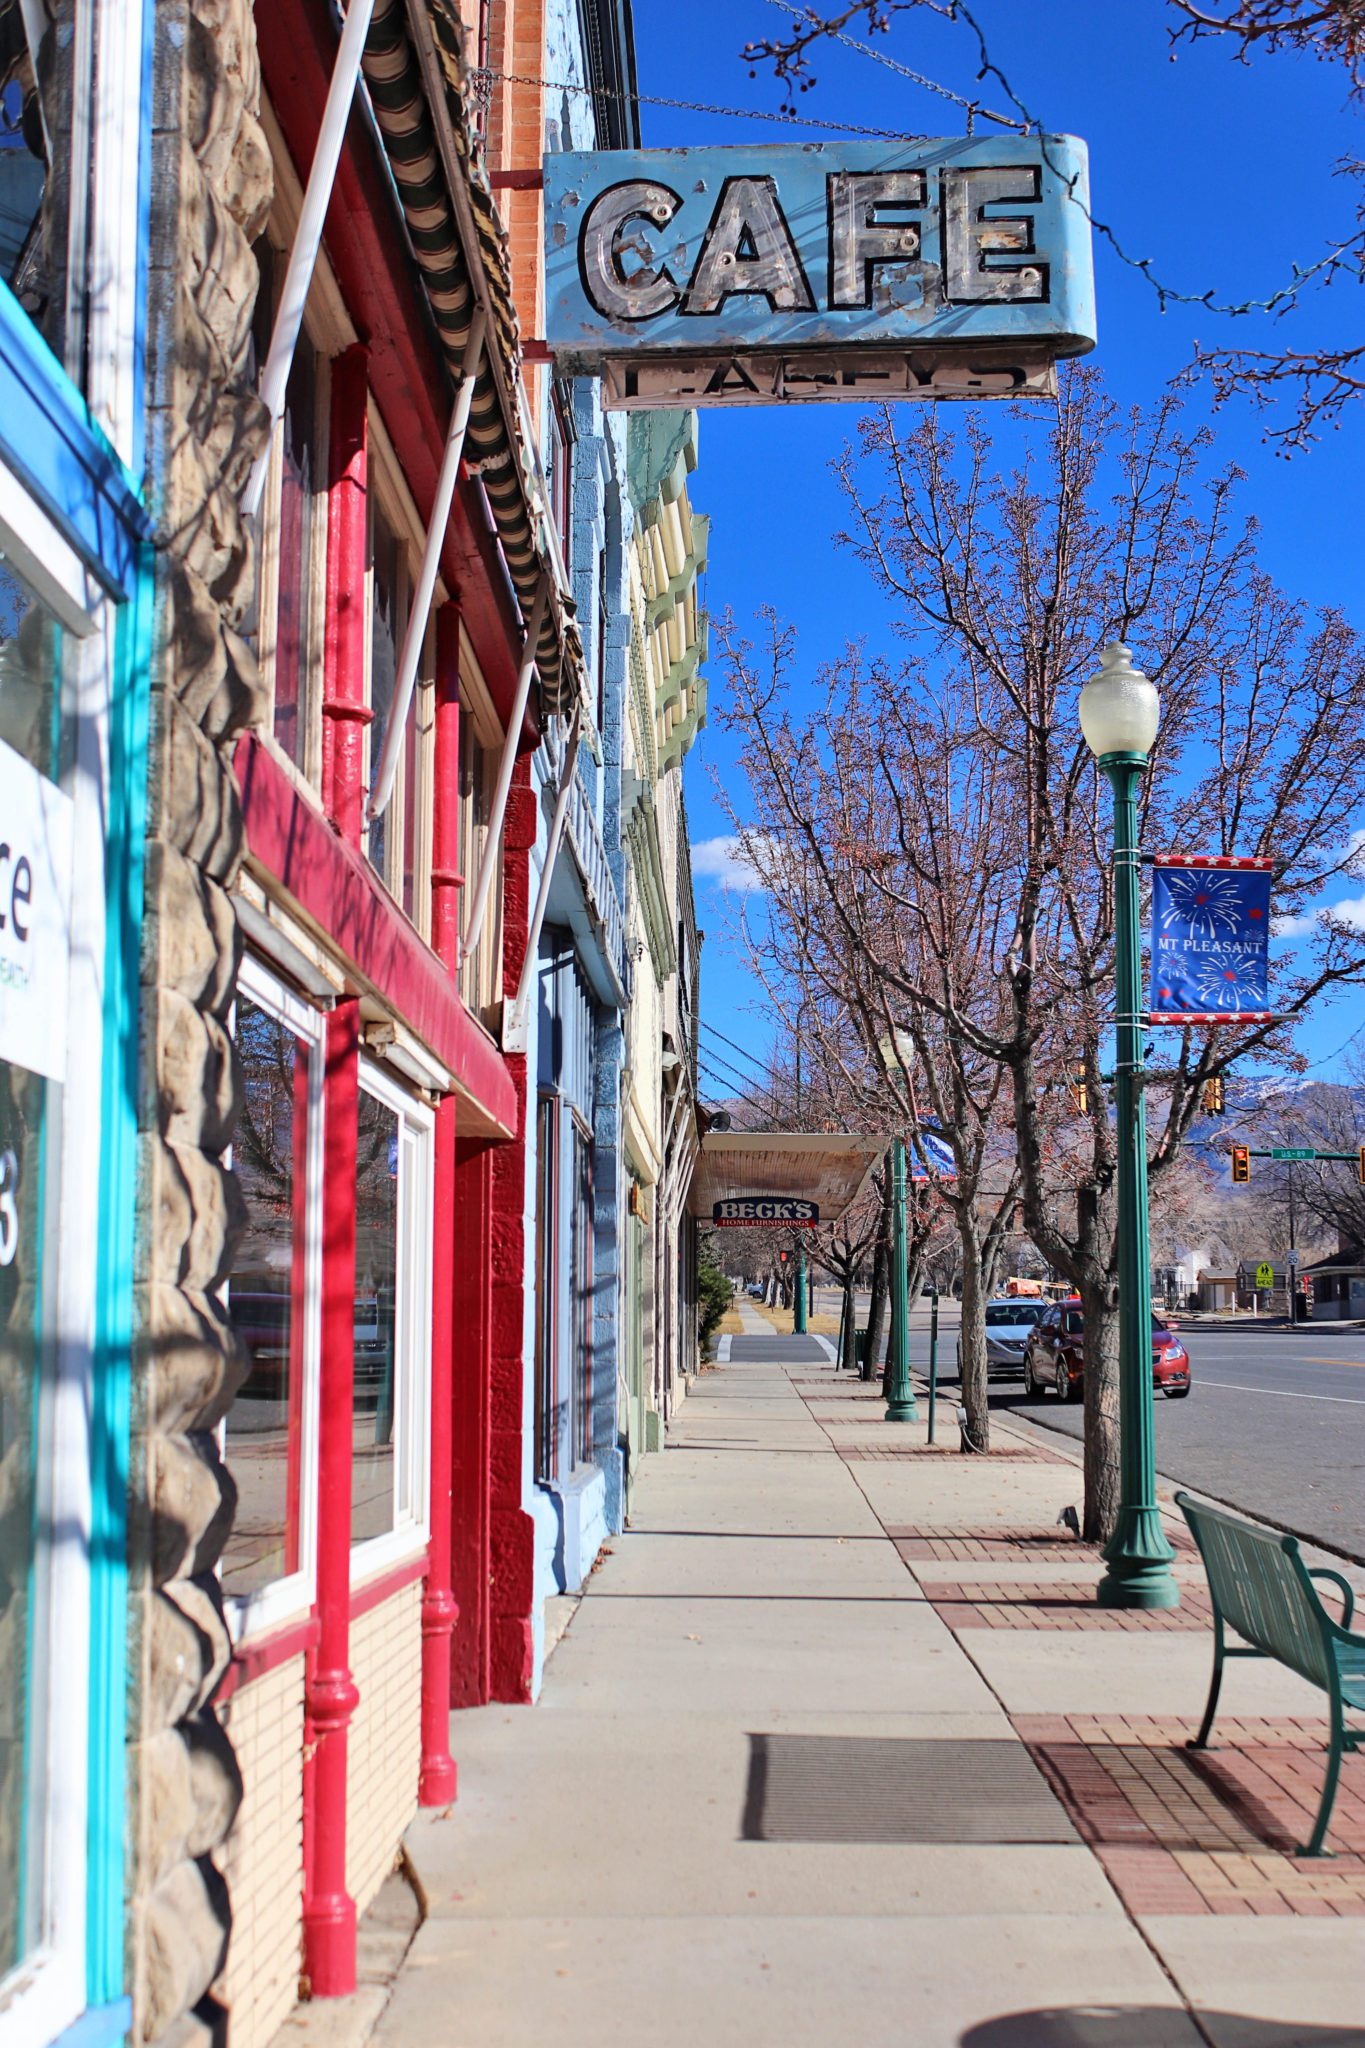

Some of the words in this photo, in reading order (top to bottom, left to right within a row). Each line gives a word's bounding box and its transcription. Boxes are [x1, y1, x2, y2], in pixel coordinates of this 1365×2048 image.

[577, 165, 1051, 323] CAFE
[1158, 938, 1179, 950] MT
[1183, 939, 1263, 954] PLEASANT
[719, 1201, 813, 1219] BECK'S
[752, 1219, 809, 1227] FURNISHINGS
